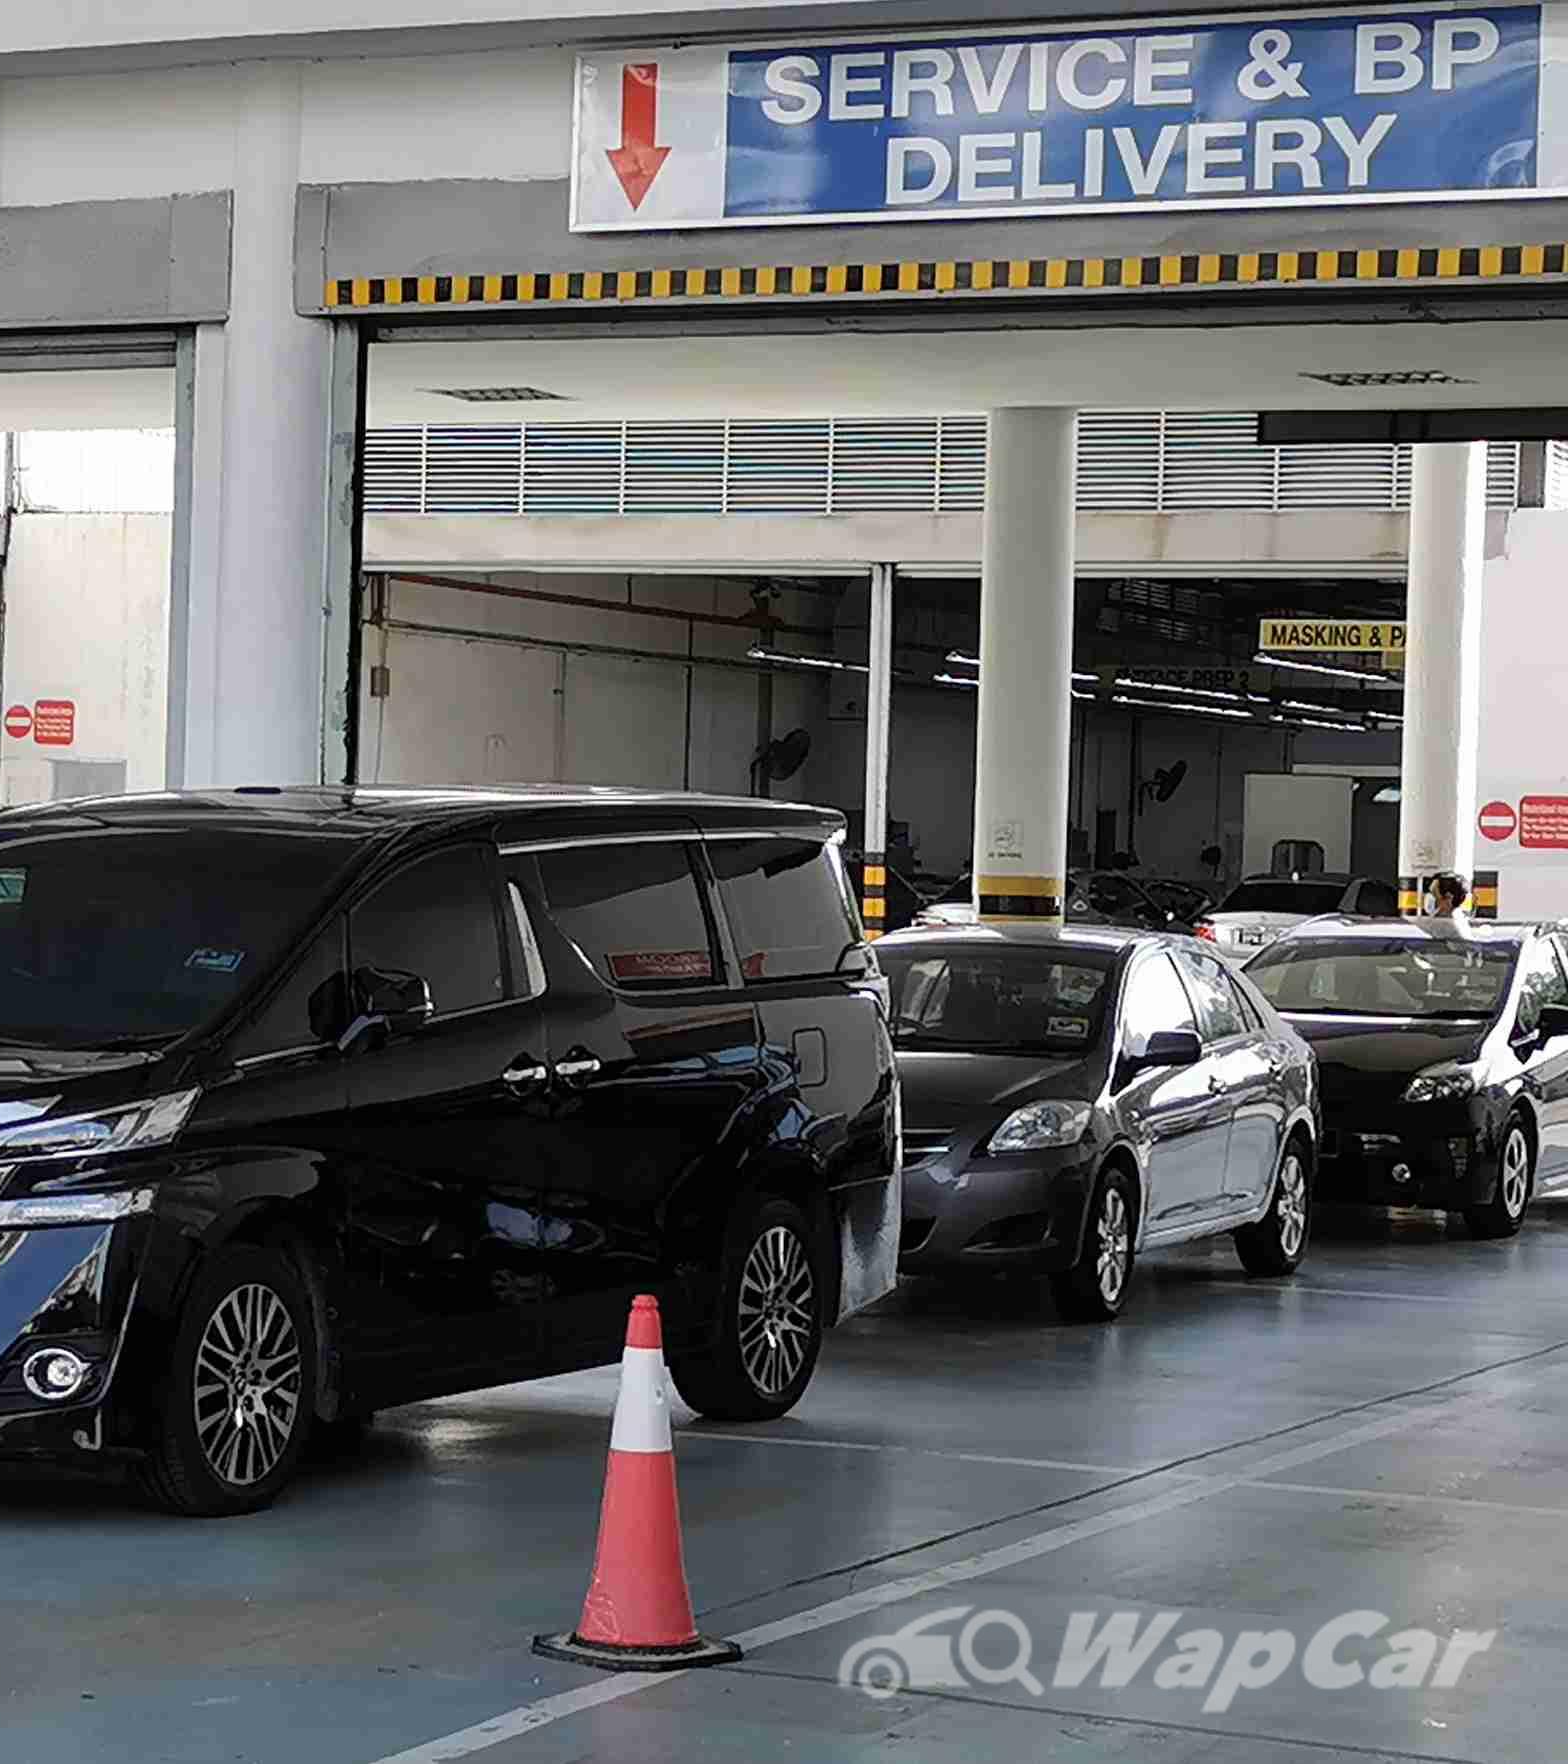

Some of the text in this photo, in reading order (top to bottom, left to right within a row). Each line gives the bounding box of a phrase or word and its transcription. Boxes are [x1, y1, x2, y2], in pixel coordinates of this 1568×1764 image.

[761, 17, 1500, 125] SERVICE & BP
[886, 113, 1398, 205] DELIVERY
[1270, 623, 1361, 647] MASKING
[1369, 625, 1382, 647] &
